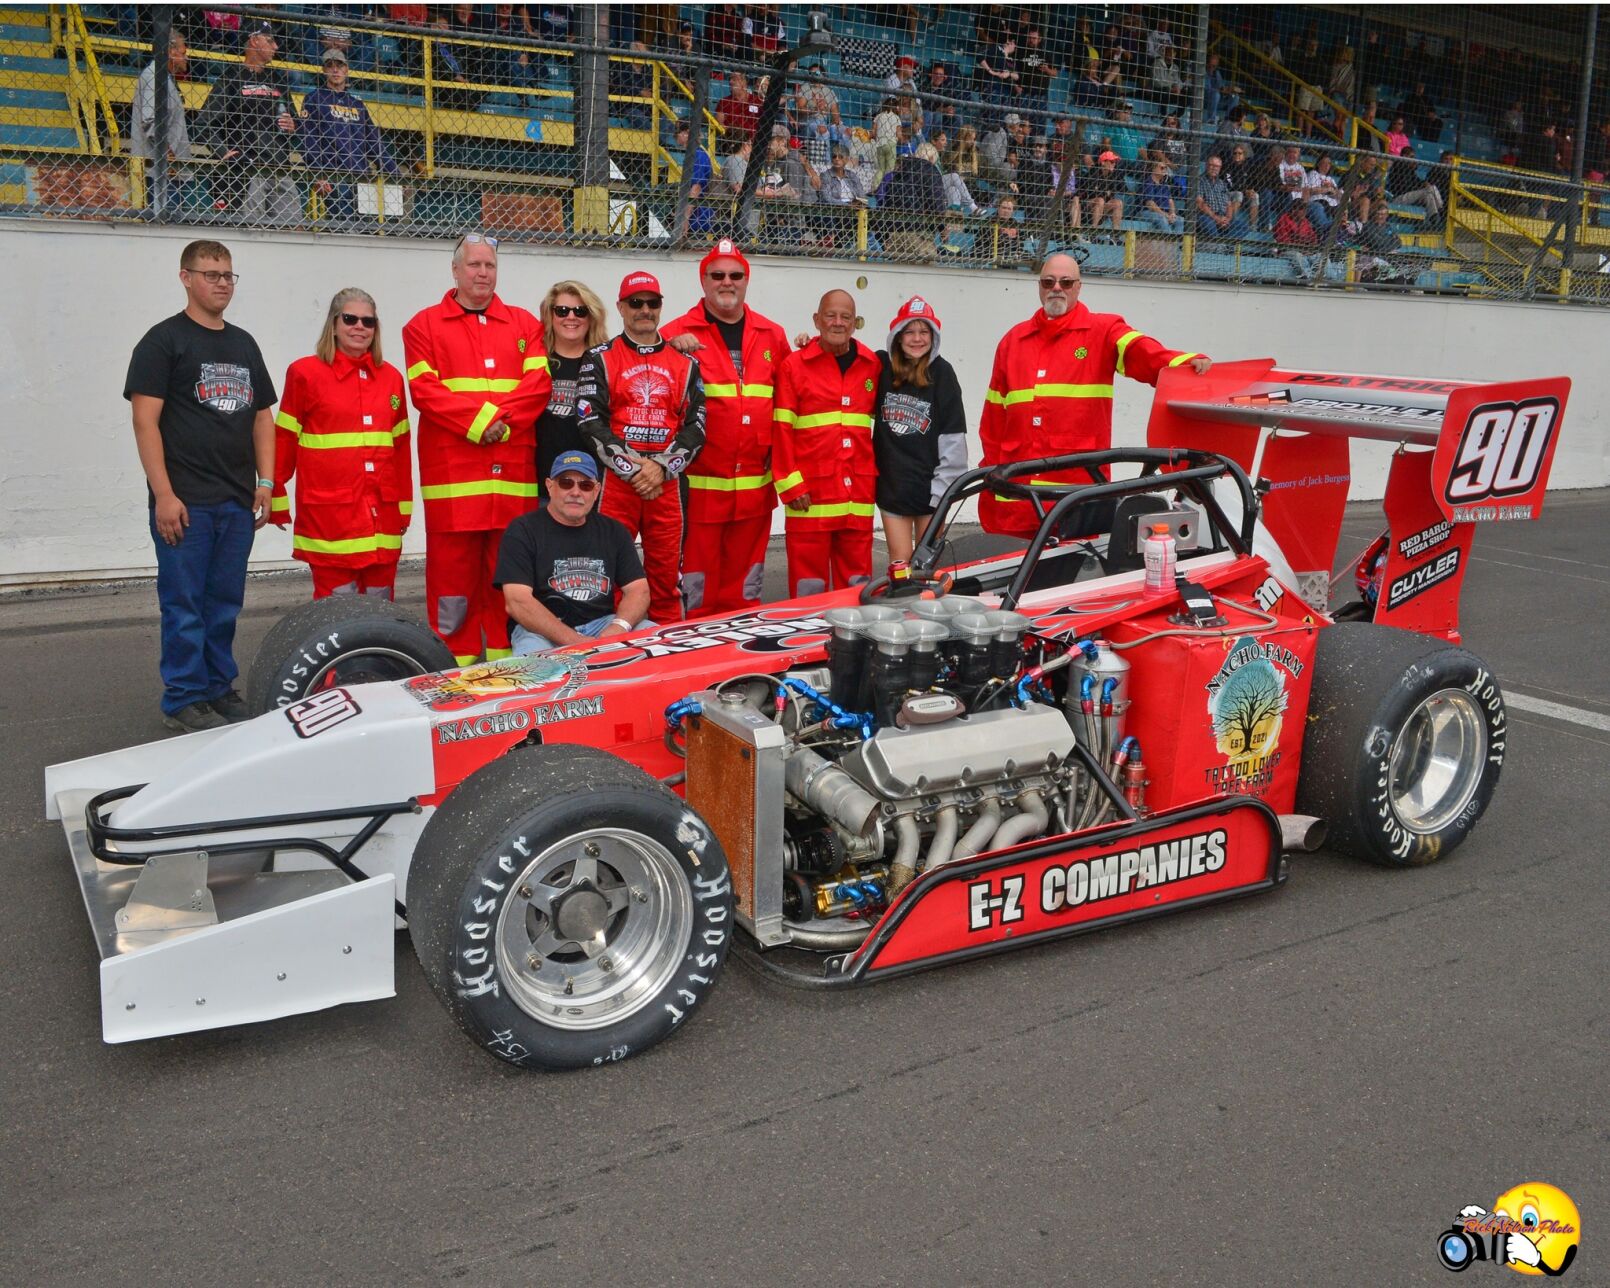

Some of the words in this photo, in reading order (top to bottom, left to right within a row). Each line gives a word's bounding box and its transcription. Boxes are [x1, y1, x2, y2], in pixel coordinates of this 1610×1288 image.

[1289, 375, 1466, 392] PATRIC
[217, 400, 237, 411] 90
[552, 404, 573, 416] 90
[891, 422, 909, 434] 90
[1446, 399, 1558, 502] 90
[1298, 477, 1307, 487] of
[1307, 476, 1323, 487] Jack
[1324, 474, 1351, 485] Burgess
[1453, 505, 1496, 522] NACHO
[1499, 504, 1534, 520] FARM
[1400, 535, 1420, 552] RED
[1406, 541, 1429, 558] PIZZA
[1429, 530, 1451, 551] SHOP
[1390, 550, 1459, 599] CUYLER
[1418, 566, 1456, 590] MANAGEMENT
[572, 589, 591, 601] 90
[647, 617, 834, 657] NGLEY
[270, 632, 340, 711] oosier
[1205, 643, 1261, 695] NACHO
[1264, 642, 1304, 680] FARM
[284, 687, 362, 739] 90
[438, 710, 530, 744] NACHO
[534, 695, 605, 726] FARM
[1465, 667, 1508, 766] Hoosier
[1230, 738, 1244, 750] EST
[1252, 733, 1268, 745] 2021
[1205, 761, 1250, 784] TATTOO
[1253, 752, 1281, 773] LOVER
[1246, 770, 1273, 790] FARM
[1371, 761, 1416, 858] Hoosier
[970, 875, 1024, 931] E-Z
[1040, 829, 1228, 912] COMPANIES
[454, 835, 531, 999] Hoosier
[664, 866, 732, 1024] Hoosier
